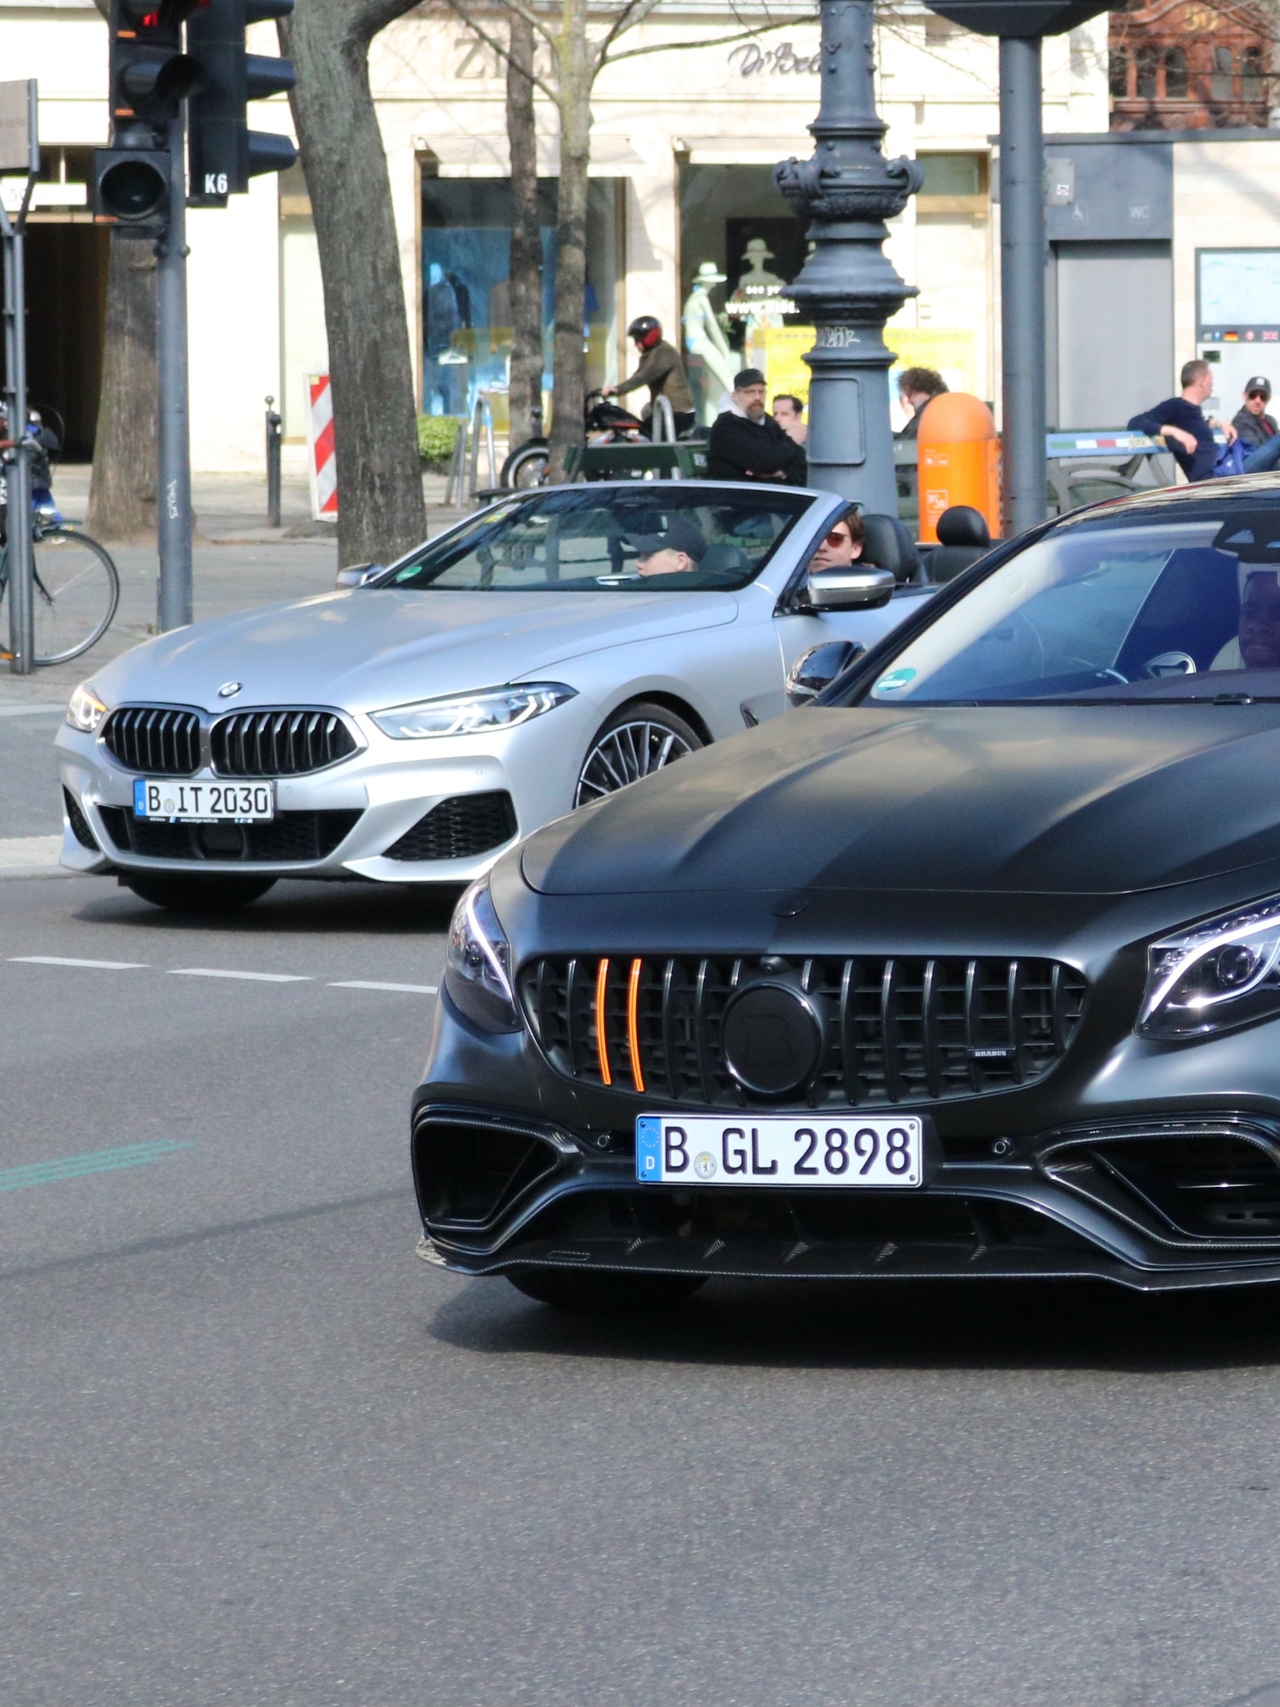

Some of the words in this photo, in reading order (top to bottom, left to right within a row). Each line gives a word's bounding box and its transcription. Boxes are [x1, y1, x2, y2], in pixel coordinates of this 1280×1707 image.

[205, 173, 228, 194] K6
[1130, 205, 1149, 219] WC
[746, 285, 765, 295] see
[767, 285, 783, 297] yo
[148, 786, 161, 811] B
[178, 787, 203, 813] IT
[209, 787, 268, 814] 2030
[665, 1126, 690, 1173] B
[722, 1127, 778, 1176] GL
[794, 1127, 912, 1176] 2898
[645, 1156, 655, 1170] D
